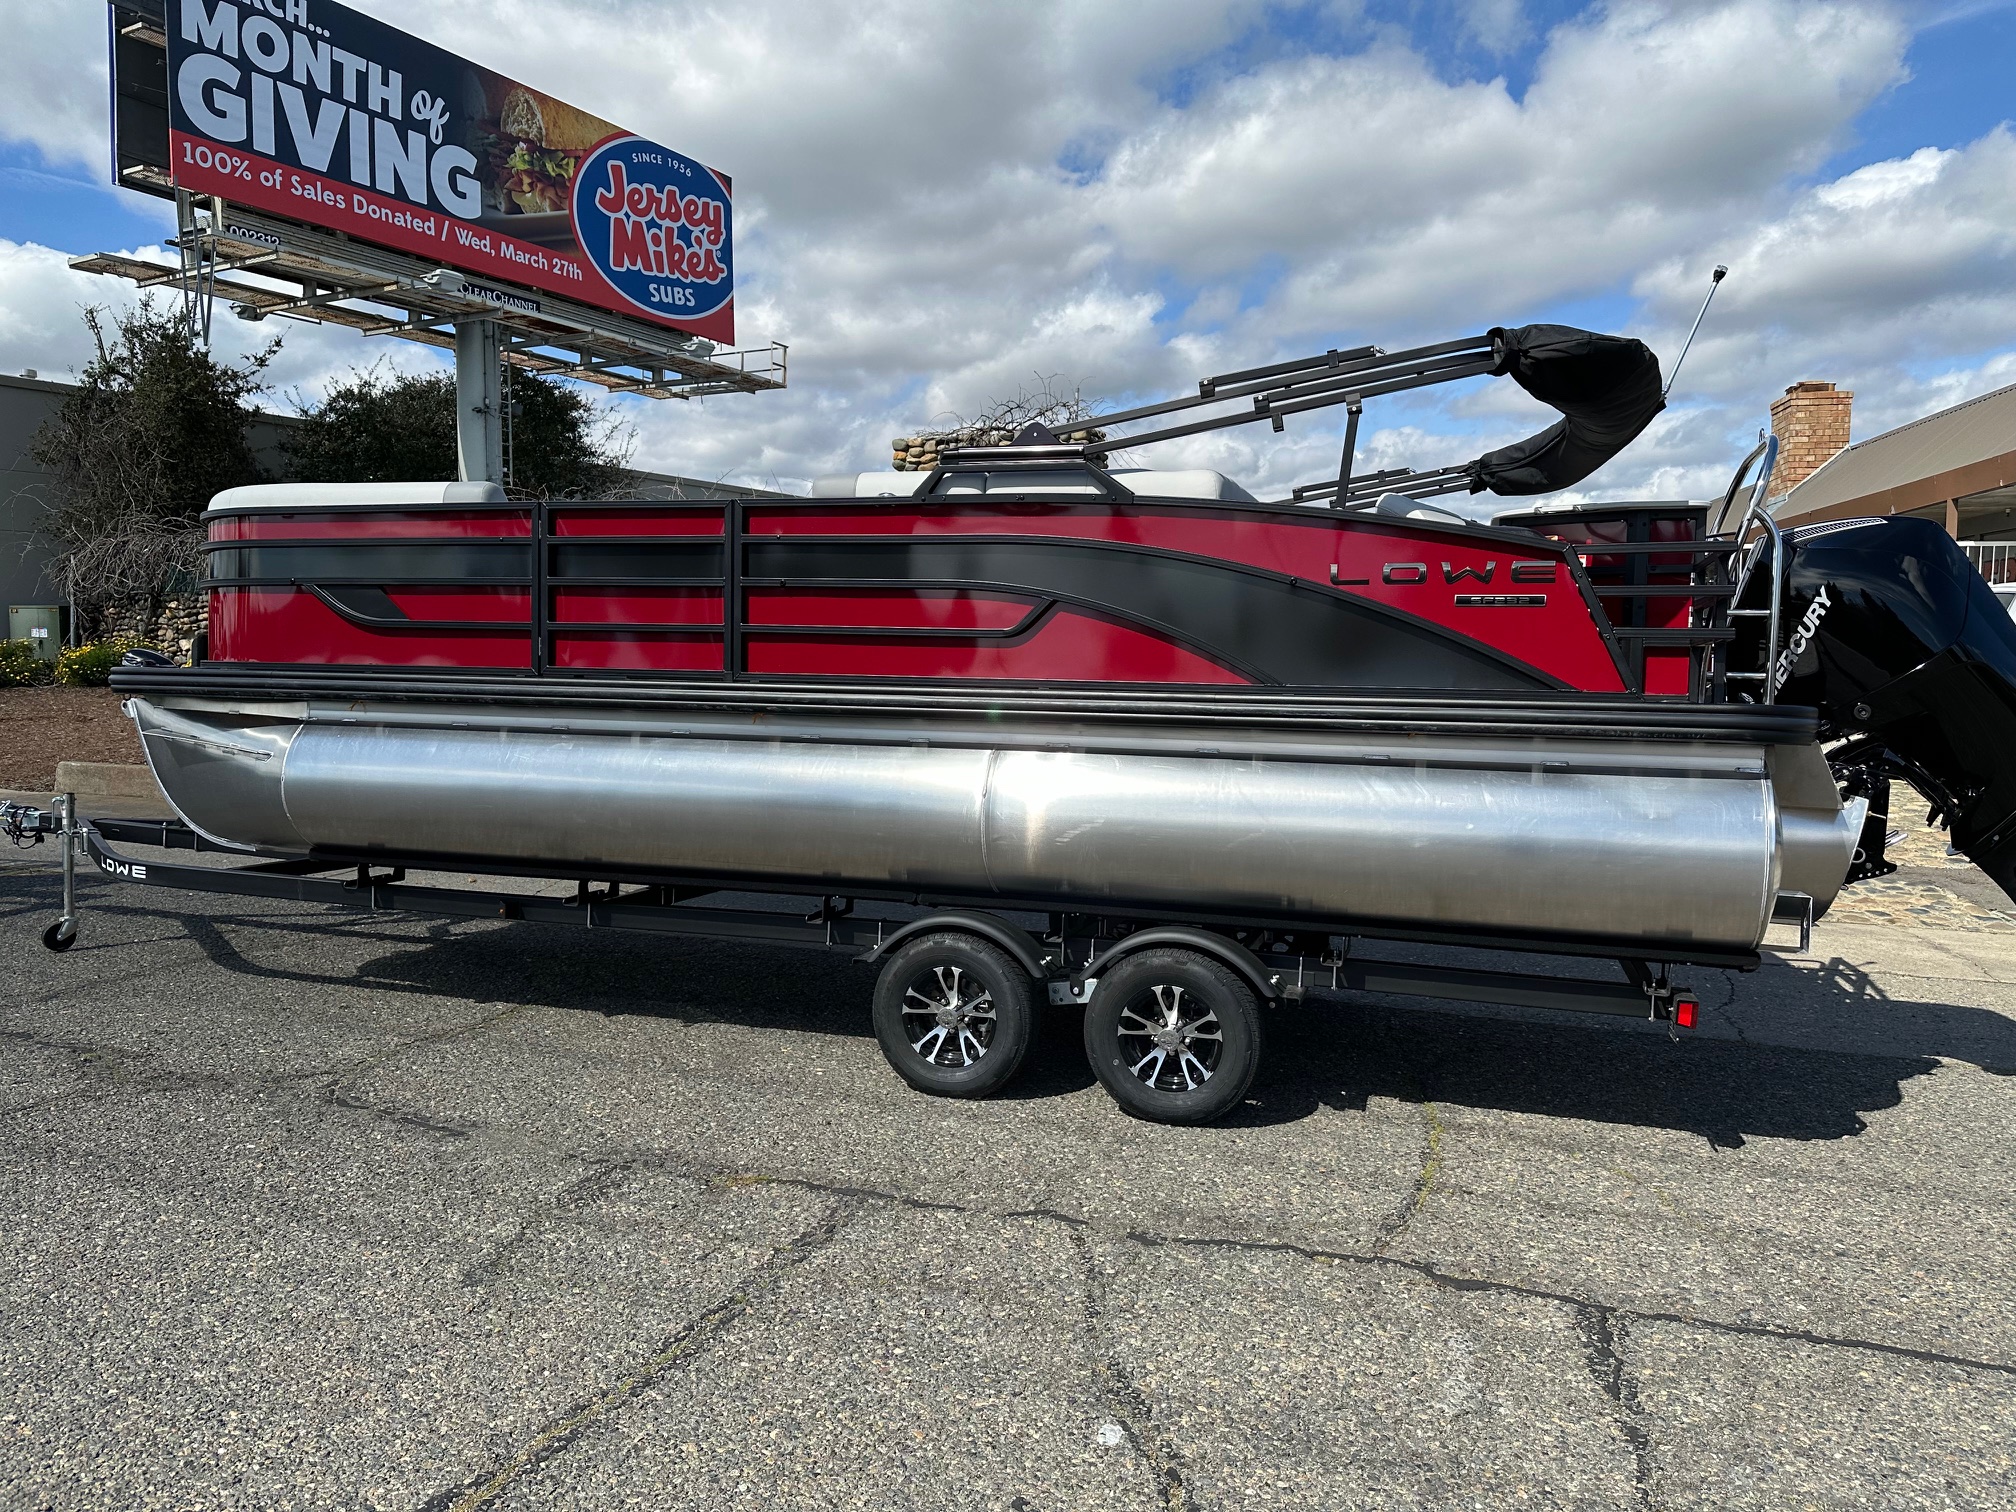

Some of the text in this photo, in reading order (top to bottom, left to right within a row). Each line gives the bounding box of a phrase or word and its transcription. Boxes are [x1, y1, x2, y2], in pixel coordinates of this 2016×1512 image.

[181, 0, 449, 144] MONTH of
[177, 53, 482, 219] GIVING
[632, 152, 692, 177] SINCE 1956
[183, 142, 251, 180] 100%
[260, 169, 282, 190] of
[290, 174, 346, 209] Sales
[353, 193, 435, 236] Donated
[455, 226, 496, 256] Wed,
[501, 241, 548, 271] March
[552, 258, 583, 281] 27th
[595, 160, 726, 249] Jersey
[609, 217, 727, 284] Mike's
[649, 283, 695, 307] SUBS
[1330, 561, 1556, 585] LOWE
[101, 854, 147, 879] LOWE
